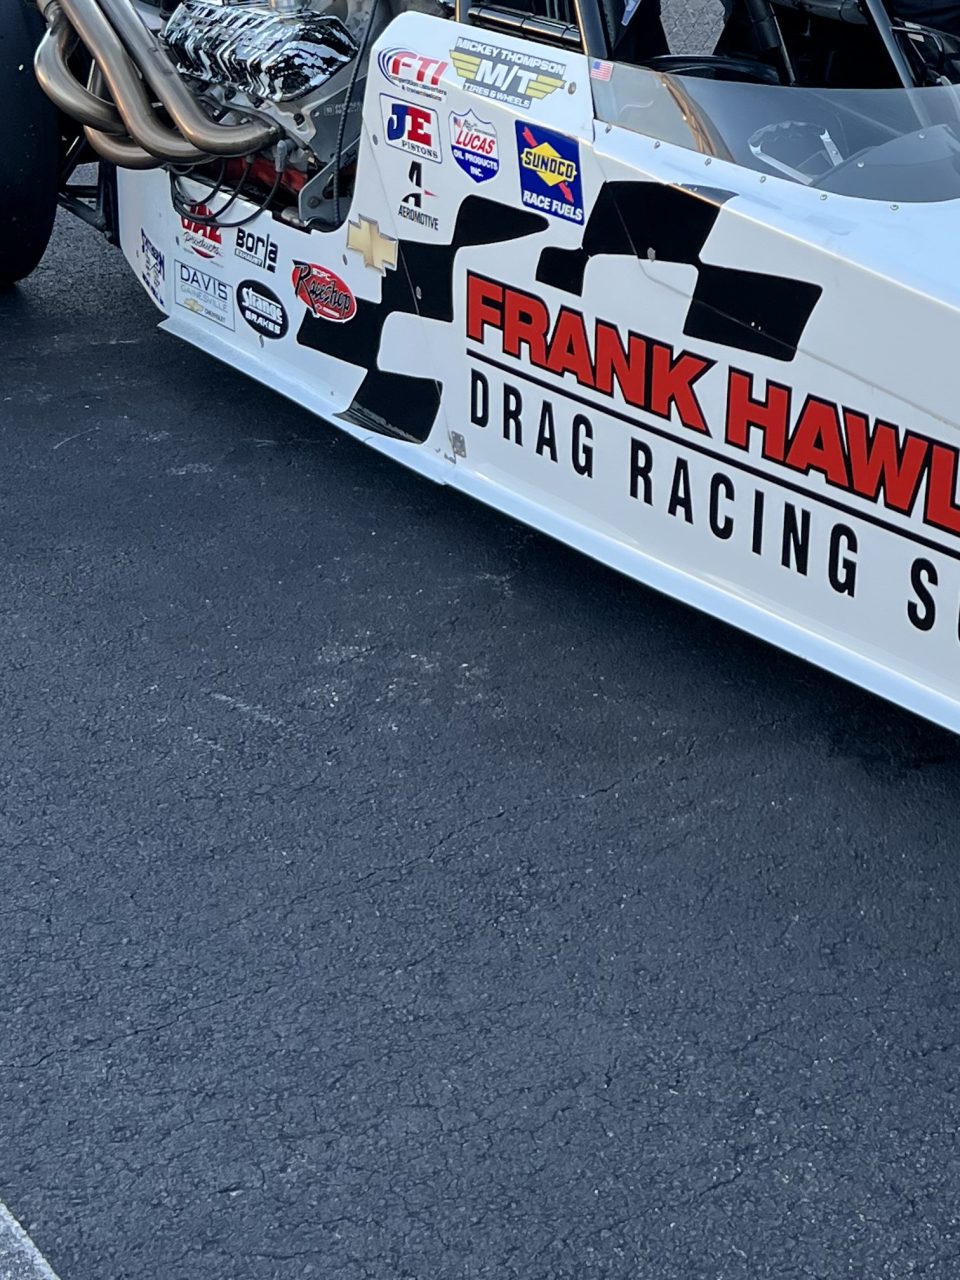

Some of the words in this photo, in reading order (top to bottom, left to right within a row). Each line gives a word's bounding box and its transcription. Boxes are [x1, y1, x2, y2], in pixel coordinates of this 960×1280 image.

[391, 51, 449, 86] FTI
[456, 38, 500, 58] MICKEY
[501, 49, 565, 75] THOMPSON
[475, 59, 538, 95] M/T
[464, 83, 489, 95] TIRES
[497, 92, 530, 108] WHEELS
[387, 103, 432, 147] JE
[401, 140, 438, 159] PISTONS
[455, 130, 496, 155] LUCAS
[453, 149, 464, 160] OIL
[465, 153, 498, 171] PRODUCTS
[524, 150, 575, 179] SUNOCO
[397, 205, 439, 231] AEROMOTIVE
[522, 190, 551, 210] RACE
[551, 199, 583, 221] FUELS
[180, 263, 228, 301] DAVIS
[180, 284, 229, 314] GAINESVILLE
[245, 310, 281, 335] BRAKES
[467, 269, 718, 438] FRANK
[471, 368, 594, 479] DRAG
[629, 436, 858, 598] RACING
